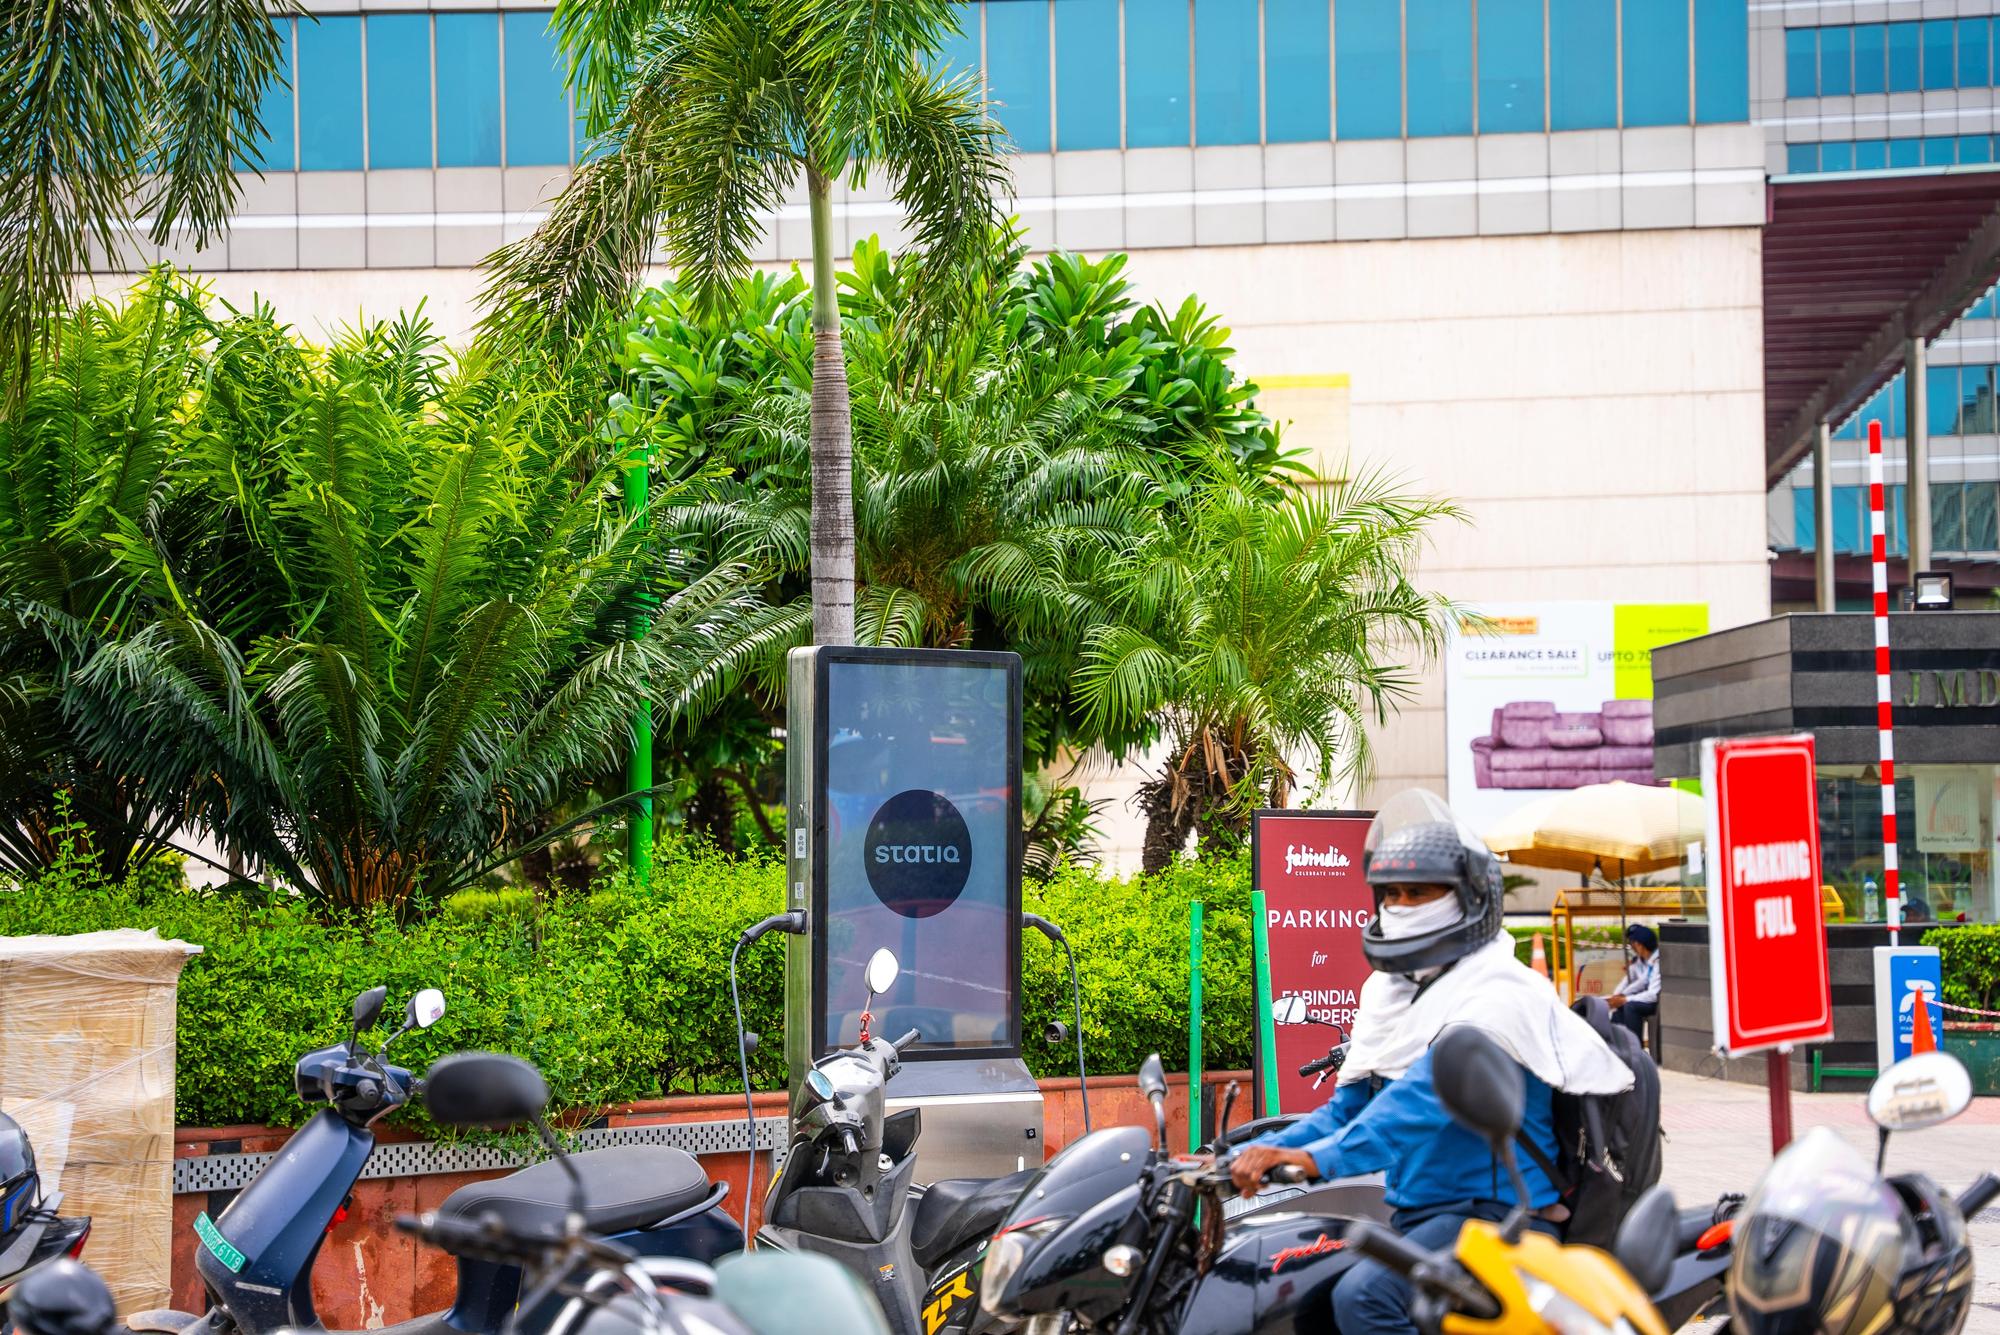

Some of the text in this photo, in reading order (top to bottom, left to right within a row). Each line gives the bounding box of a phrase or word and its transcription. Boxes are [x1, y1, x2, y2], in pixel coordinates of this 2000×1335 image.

[1465, 649, 1578, 661] CLEARANCE SALE
[1597, 651, 1635, 662] UPTO
[1904, 669, 2000, 708] JMD
[1285, 844, 1350, 875] fabindia
[1731, 839, 1811, 888] PARKING
[1268, 909, 1368, 929] PARKING
[1754, 895, 1798, 940] FULL
[1311, 950, 1328, 968] for
[217, 1245, 241, 1269] 6119
